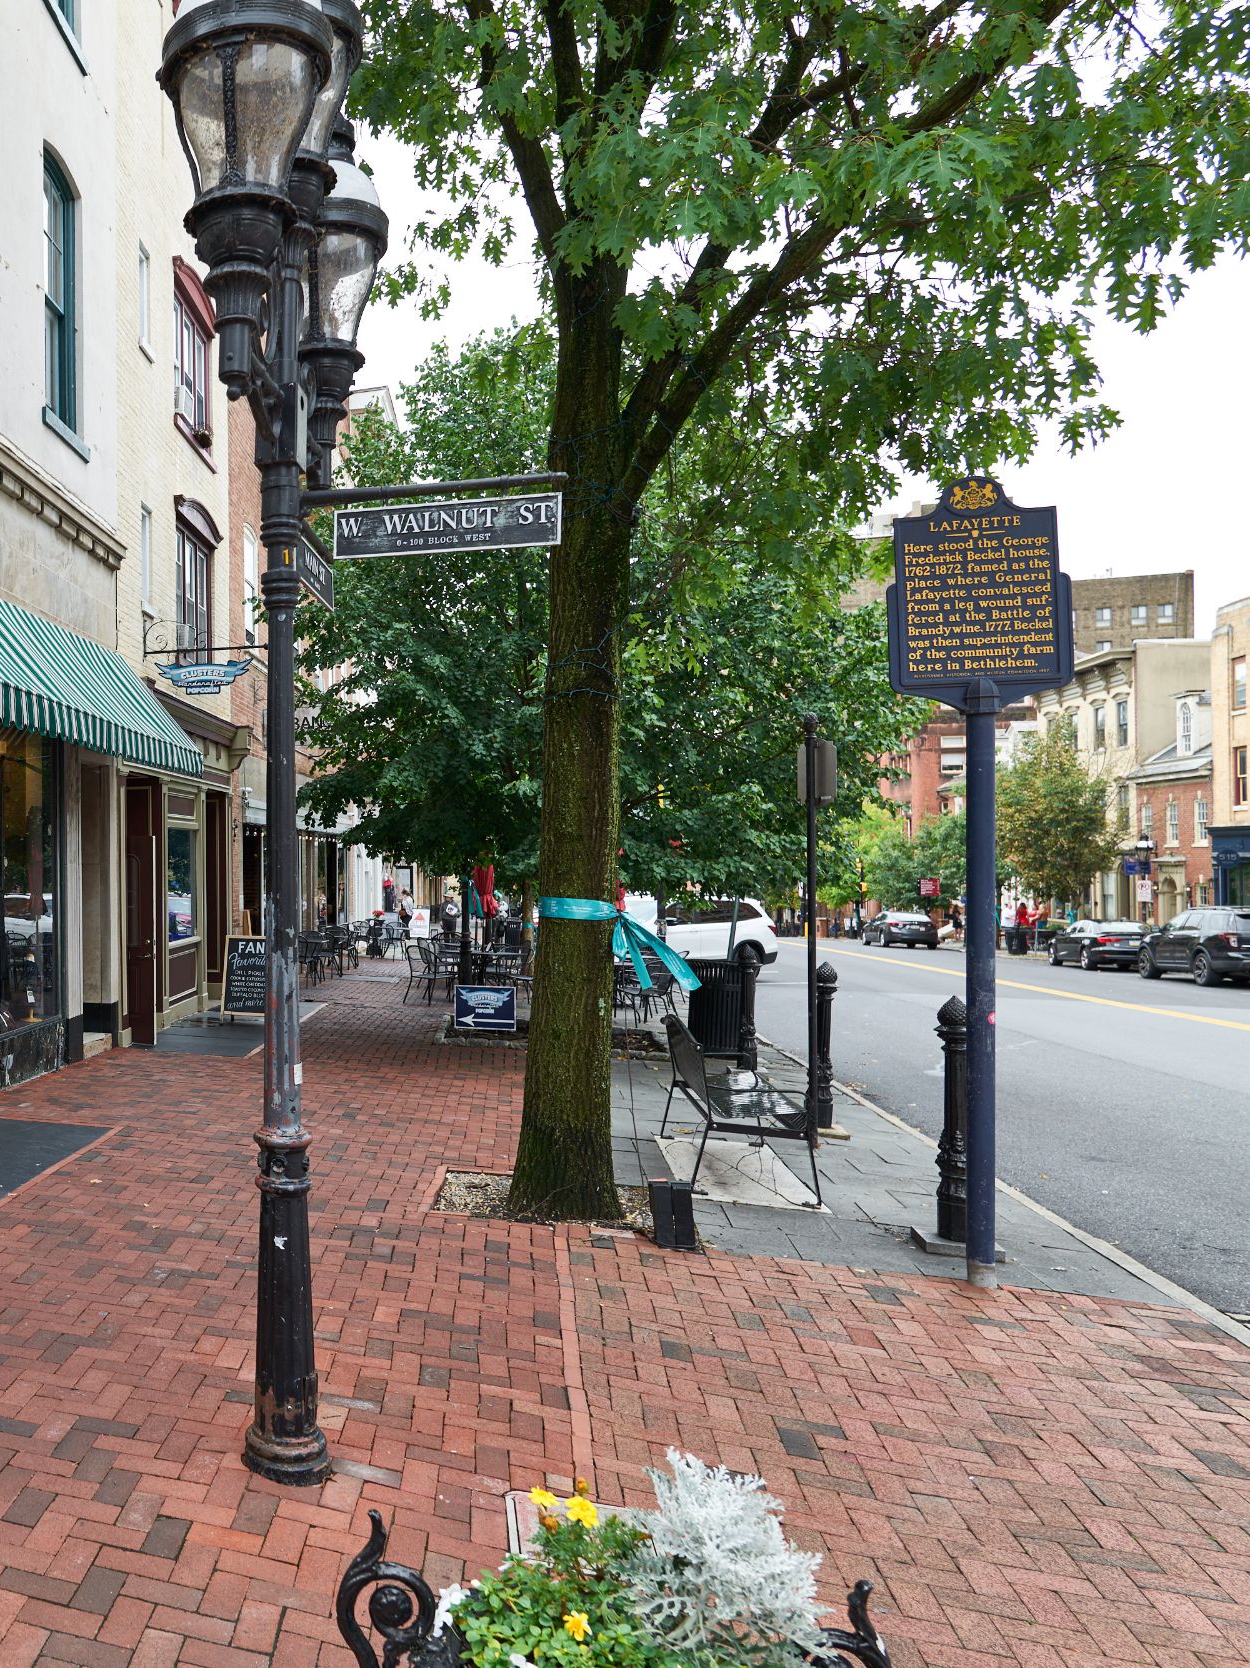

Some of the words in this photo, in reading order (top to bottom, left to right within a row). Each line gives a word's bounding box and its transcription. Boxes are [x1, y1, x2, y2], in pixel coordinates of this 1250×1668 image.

[339, 517, 362, 538] W.
[383, 506, 499, 535] WALNUT
[518, 502, 556, 525] ST.
[929, 515, 1021, 532] LAFAYETTE
[428, 535, 459, 545] BLOCK
[464, 532, 492, 542] WEST
[904, 543, 934, 553] Here
[938, 539, 974, 551] stood
[977, 537, 999, 548] the
[1002, 535, 1050, 547] George
[304, 547, 319, 577] MAIN
[904, 553, 963, 565] Frederick
[967, 548, 1006, 561] Beckel
[966, 561, 1008, 573] famed
[1011, 561, 1026, 570] as
[1029, 558, 1051, 569] the
[906, 578, 941, 590] place
[946, 575, 989, 586] where
[995, 570, 1051, 583] General
[906, 589, 967, 601] Lafayette
[971, 582, 1051, 597] convalesced
[906, 602, 940, 612] from
[955, 600, 974, 611] leg
[978, 596, 1022, 608] wound
[1026, 594, 1052, 605] suf-
[907, 612, 944, 624] fered
[948, 612, 961, 622] at
[965, 610, 987, 621] the
[991, 608, 1031, 620] Battle
[1036, 606, 1053, 617] of
[1013, 618, 1053, 630] Beckel
[908, 639, 930, 649] was
[932, 636, 961, 648] then
[963, 631, 1054, 646] superintendent
[908, 649, 923, 660] of
[926, 649, 947, 659] the
[950, 646, 1020, 658] community
[1022, 643, 1055, 655] farm
[908, 661, 943, 672] here
[947, 660, 960, 670] in
[964, 656, 1039, 670] Bethlehem.
[180, 669, 225, 680] CLUSTERS
[186, 686, 220, 694] POPCORN
[238, 941, 266, 954] FAN
[227, 998, 244, 1009] and
